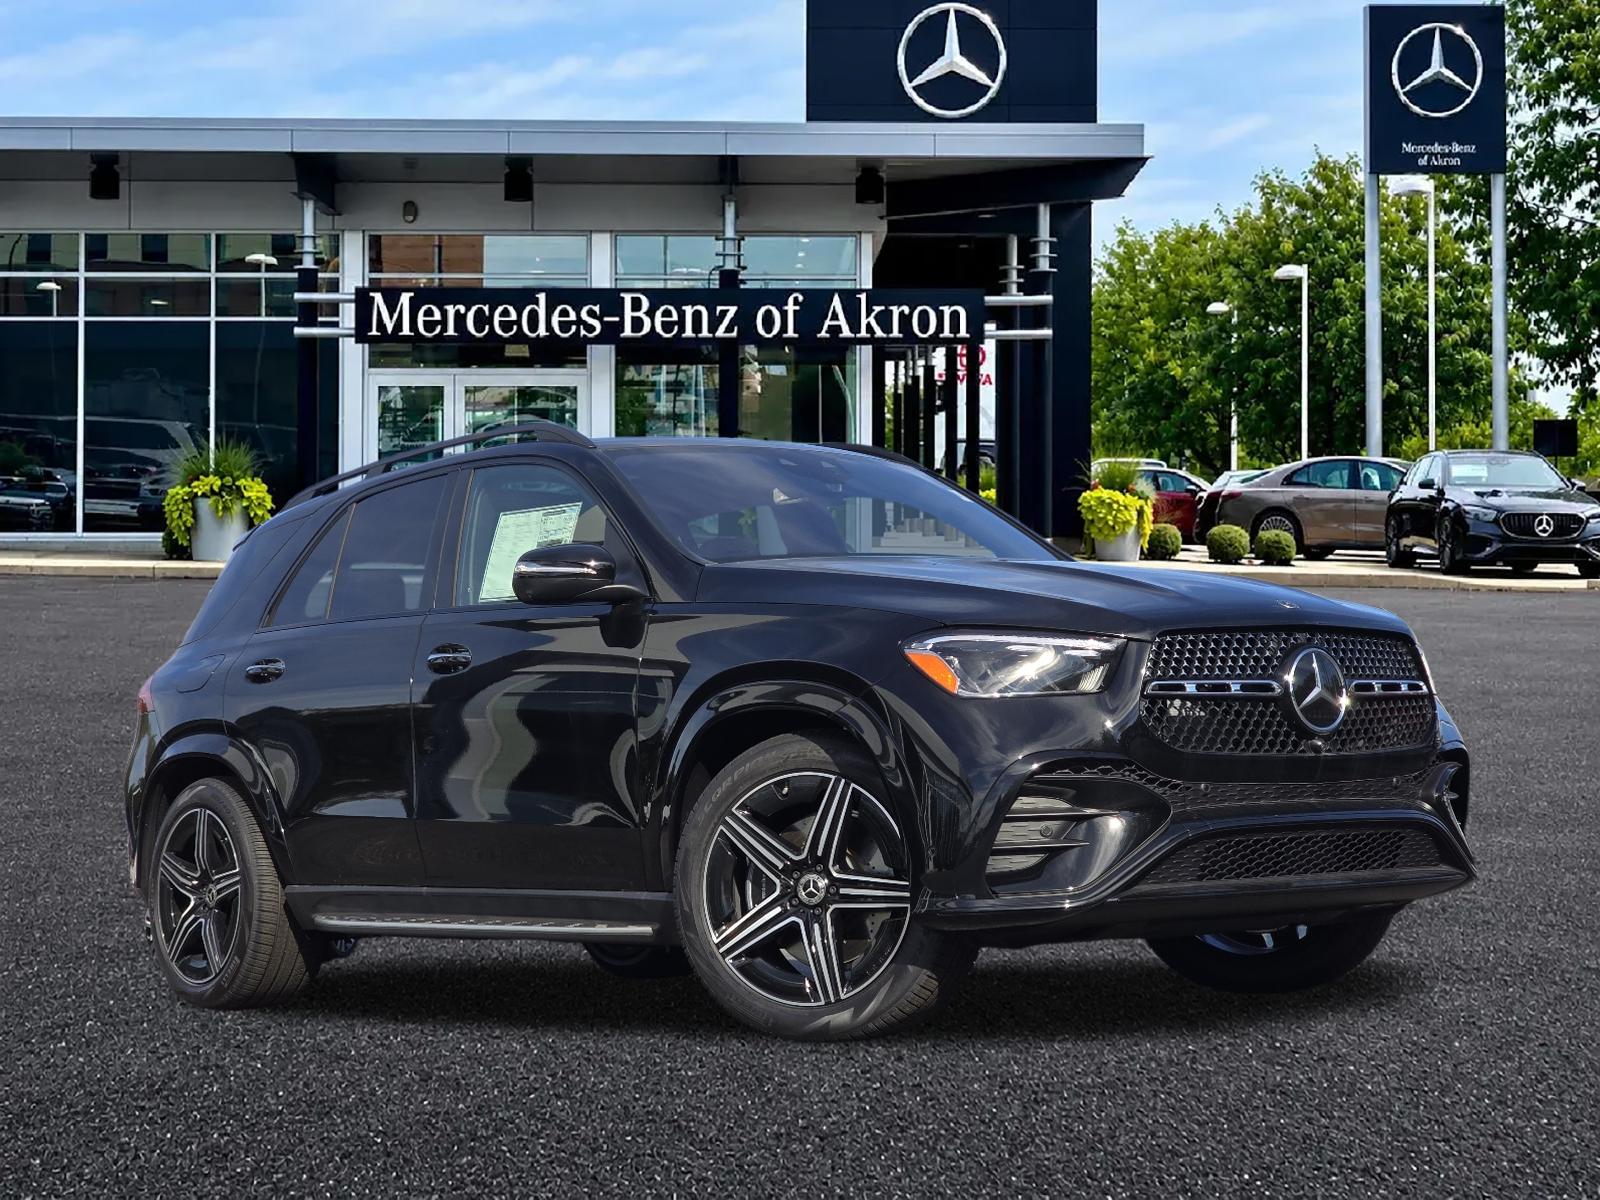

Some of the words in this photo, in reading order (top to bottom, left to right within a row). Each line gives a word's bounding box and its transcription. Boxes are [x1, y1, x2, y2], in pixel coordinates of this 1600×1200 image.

[1401, 141, 1477, 153] Mercedes-Benz
[1417, 154, 1428, 166] of
[1430, 154, 1461, 166] Akron
[367, 291, 738, 338] Mercedes-Benz
[755, 292, 804, 338] of
[816, 291, 971, 338] Akron
